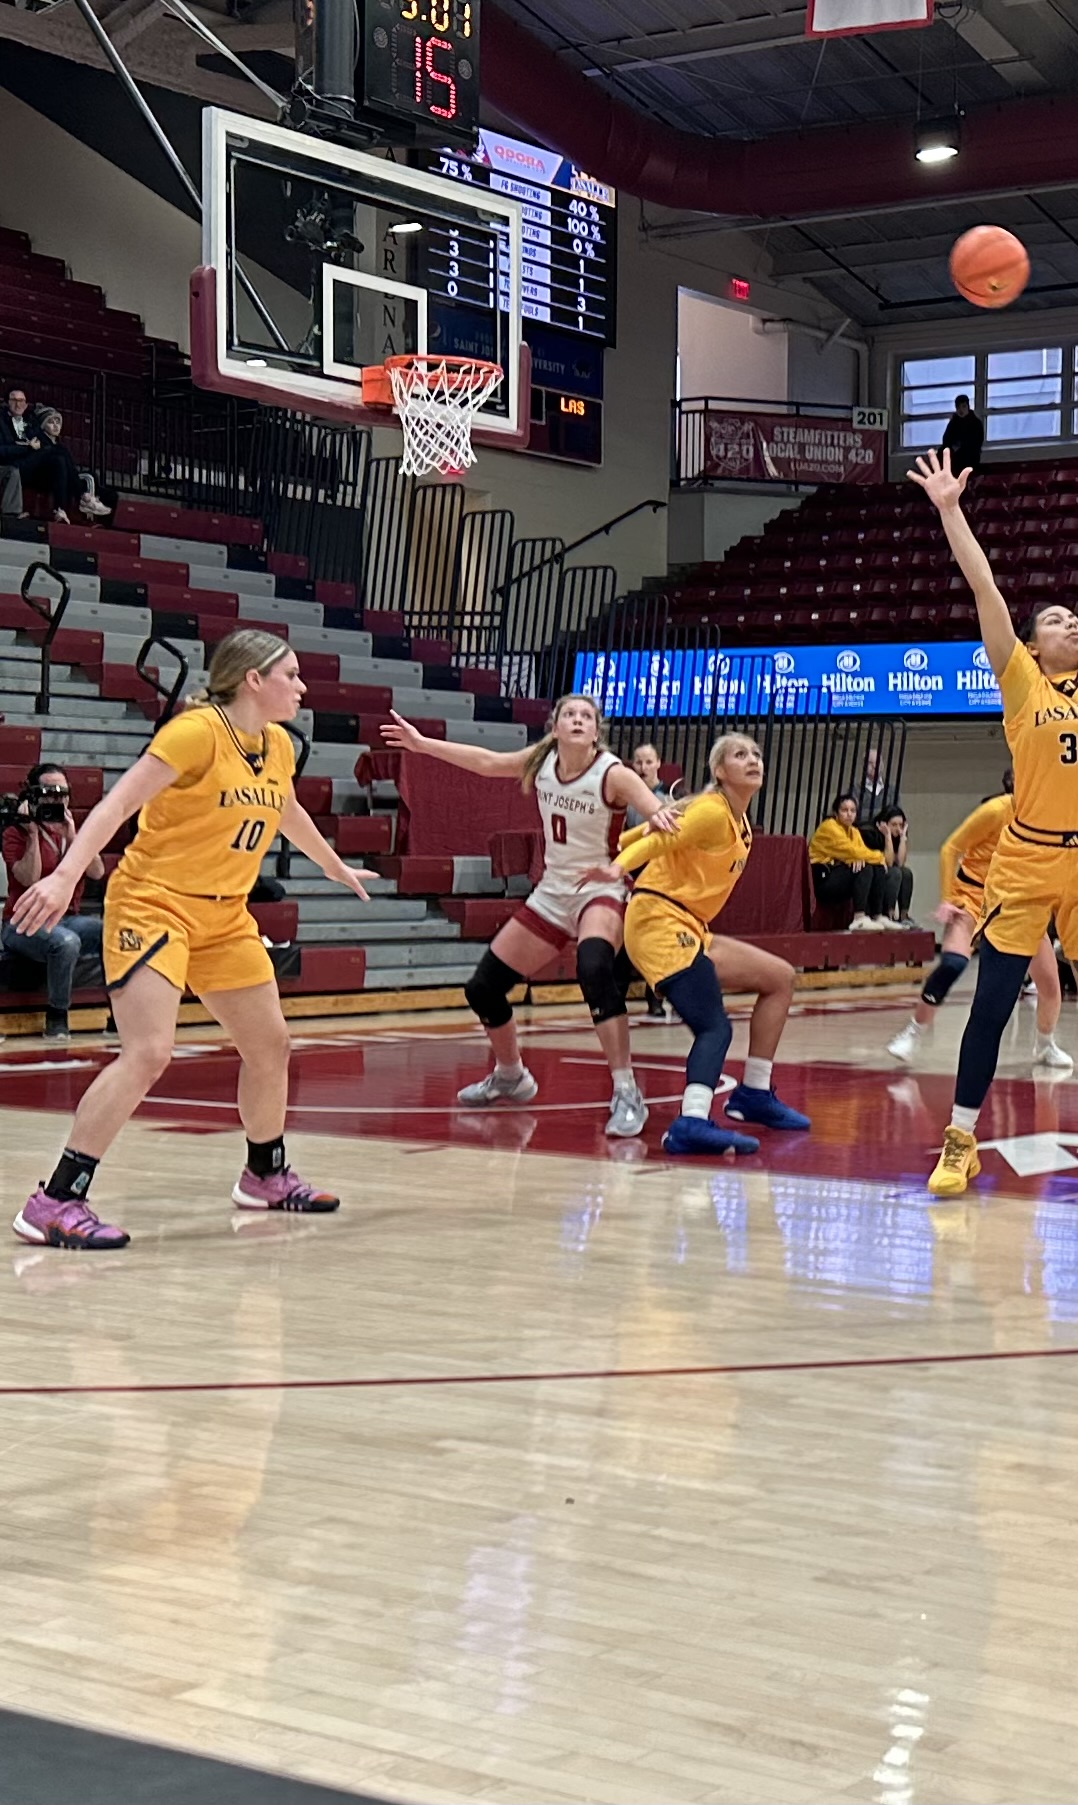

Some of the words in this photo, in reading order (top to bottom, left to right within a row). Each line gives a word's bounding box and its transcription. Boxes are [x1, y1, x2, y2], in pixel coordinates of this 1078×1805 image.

[413, 37, 457, 119] 15
[494, 145, 546, 170] QDOBA
[440, 157, 459, 176] 75
[462, 165, 473, 181] %
[510, 183, 541, 200] SHOOTING
[569, 199, 587, 217] 40
[589, 206, 600, 221] %
[567, 217, 589, 236] 100
[591, 225, 601, 240] %
[449, 241, 459, 257] 3
[572, 238, 582, 255] 0
[449, 260, 459, 277] 3
[447, 281, 458, 297] 0
[577, 297, 586, 312] 3
[560, 397, 584, 415] LAS
[857, 411, 885, 426] 201
[773, 427, 863, 448] STEAMFITTERS
[768, 442, 800, 459] OCAL
[805, 446, 844, 463] UNION
[848, 449, 874, 465] 420
[822, 672, 875, 693] Hilton
[888, 671, 943, 692] Hilton
[554, 794, 595, 815] JOSEPH'S
[230, 819, 266, 852] 10
[551, 813, 567, 846] 0
